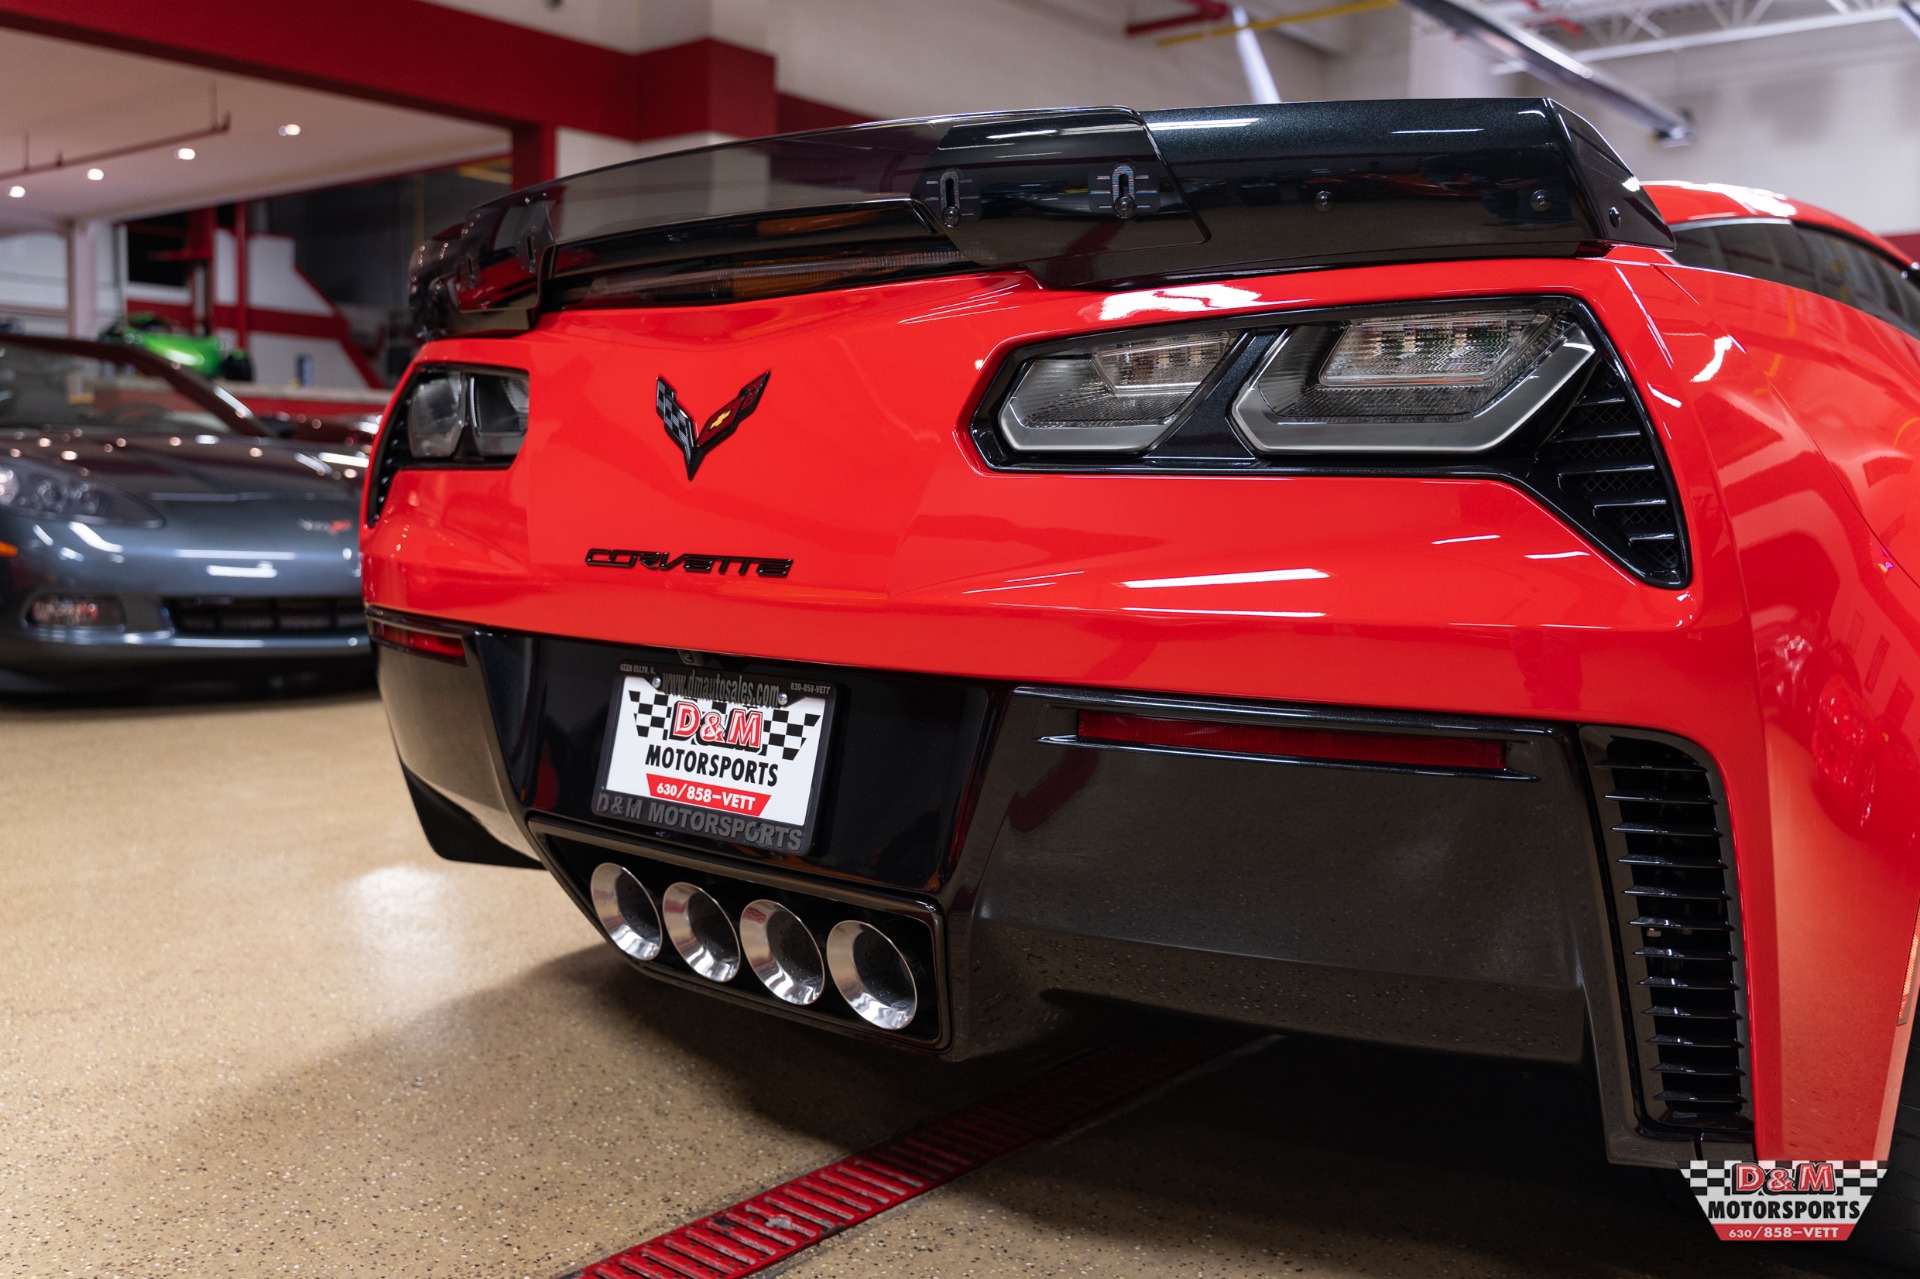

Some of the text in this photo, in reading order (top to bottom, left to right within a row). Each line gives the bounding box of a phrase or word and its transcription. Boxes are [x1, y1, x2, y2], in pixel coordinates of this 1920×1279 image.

[585, 548, 793, 578] CORVETTE
[662, 669, 780, 707] www.dmautosales.com
[790, 682, 831, 695] 630-858-VETT
[671, 700, 763, 752] D&M
[645, 744, 778, 787] MOTORSPORTS
[656, 782, 756, 811] 630/858-VETT
[596, 792, 804, 852] D&M MOTORSPORTS
